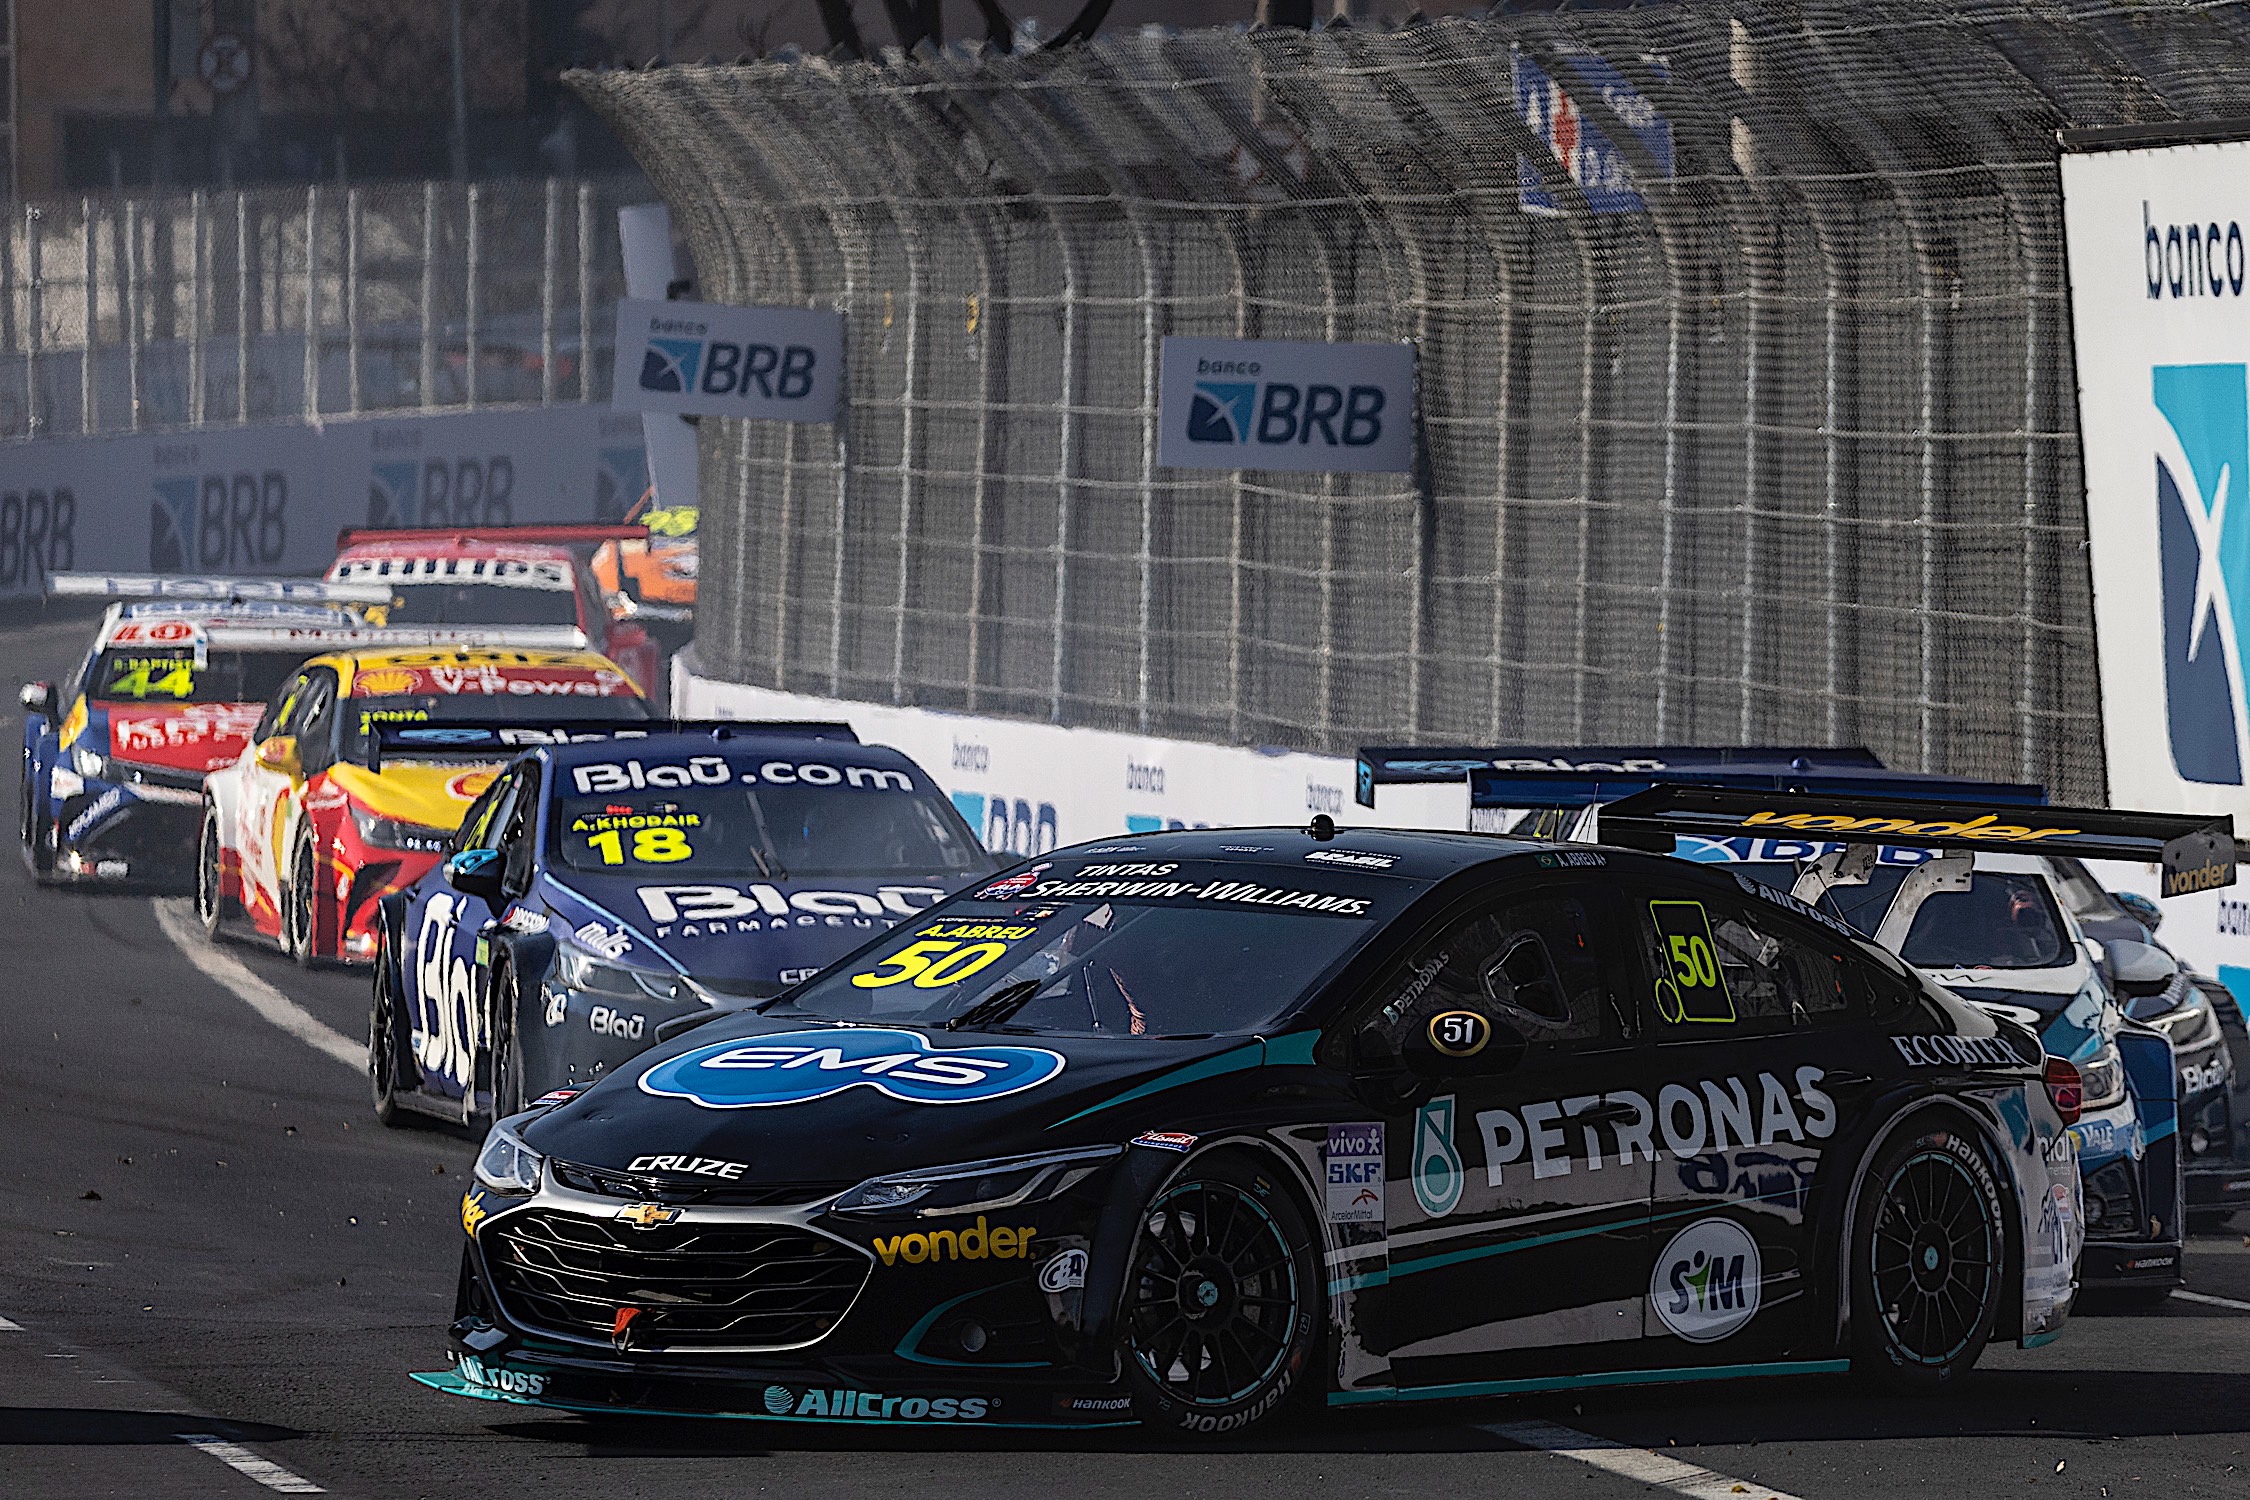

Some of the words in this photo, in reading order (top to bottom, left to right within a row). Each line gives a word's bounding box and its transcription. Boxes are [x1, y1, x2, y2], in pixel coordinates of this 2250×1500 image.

[2142, 199, 2244, 299] banco
[650, 318, 708, 334] banco
[702, 341, 815, 398] BRB
[1197, 357, 1262, 376] banco
[1257, 381, 1386, 446] BRB
[201, 468, 287, 570] BRB
[110, 667, 194, 698] 44
[952, 734, 990, 773] banco
[1128, 755, 1165, 795] banco
[1306, 775, 1344, 815] banco
[572, 814, 700, 832] A.KHODAIR
[1741, 811, 2081, 841] vonder
[587, 827, 693, 865] 18
[1075, 863, 1178, 877] TINTAS
[2168, 859, 2229, 895] vonder
[1758, 884, 1851, 937] AllCross
[915, 924, 1037, 940] A.ABREU
[851, 940, 1007, 988] 50
[1669, 935, 1717, 988] 50
[1393, 950, 1450, 1015] PETRONAS
[1443, 1017, 1474, 1044] 51
[700, 1047, 1009, 1085] EMS
[1890, 1035, 2027, 1067] ECOBIER
[1328, 1130, 1366, 1154] vivo
[1475, 1065, 1839, 1188] PETRONAS
[627, 1155, 749, 1181] CRUZE
[1328, 1162, 1381, 1184] SKF
[1331, 1209, 1373, 1221] ArcelorMittal
[872, 1215, 1037, 1267] vonder
[795, 1388, 989, 1419] AllCross
